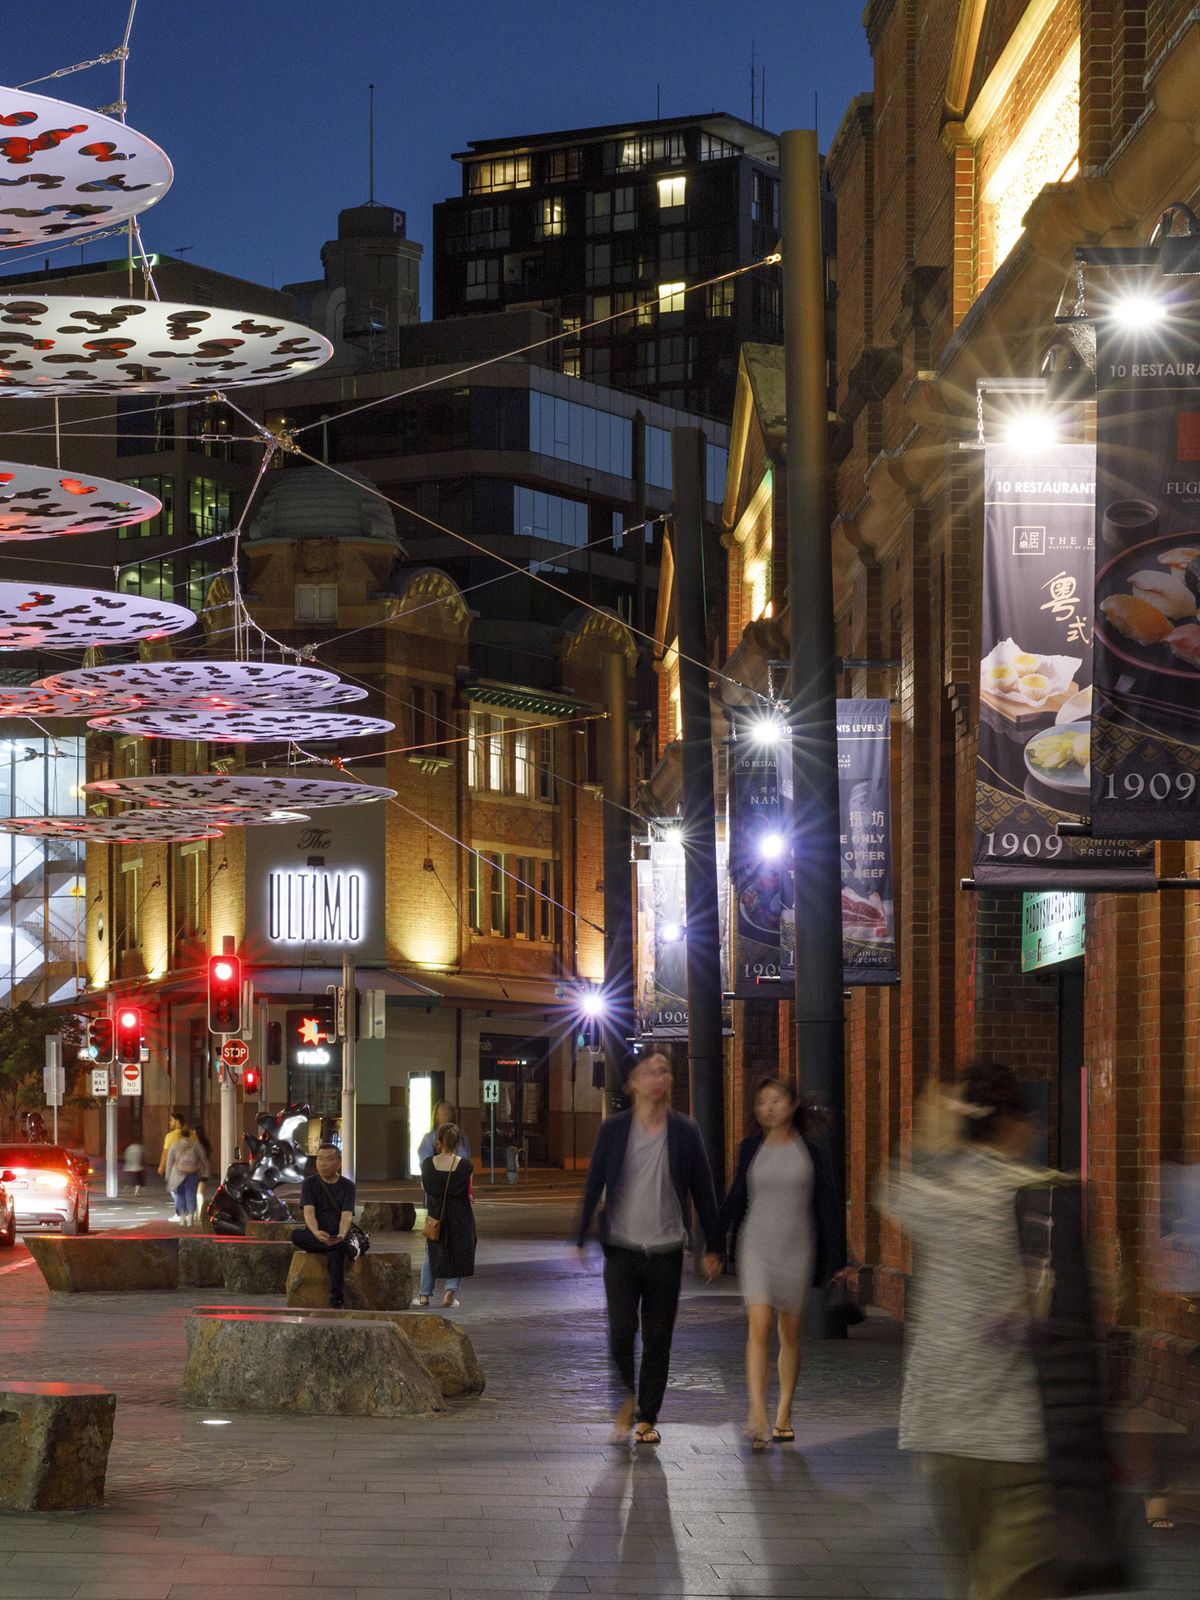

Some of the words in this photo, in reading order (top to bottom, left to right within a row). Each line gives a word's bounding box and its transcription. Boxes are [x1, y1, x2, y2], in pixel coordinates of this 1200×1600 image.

[393, 212, 403, 232] P
[1110, 364, 1127, 378] 10
[996, 481, 1011, 494] 10
[1048, 536, 1078, 545] THE
[852, 724, 876, 733] LEVEL
[877, 724, 884, 732] 3
[741, 760, 750, 768] 10
[1104, 772, 1196, 800] 1909
[296, 828, 332, 850] The
[851, 833, 885, 844] ONLY
[1079, 838, 1127, 847] DINING
[984, 832, 1064, 859] 1909
[844, 851, 886, 861] OFFER
[1079, 849, 1142, 858] PRECINCT
[855, 869, 886, 878] BEEF
[269, 873, 360, 941] ULTIMO
[223, 1047, 246, 1058] STOP
[296, 1048, 331, 1065] nab
